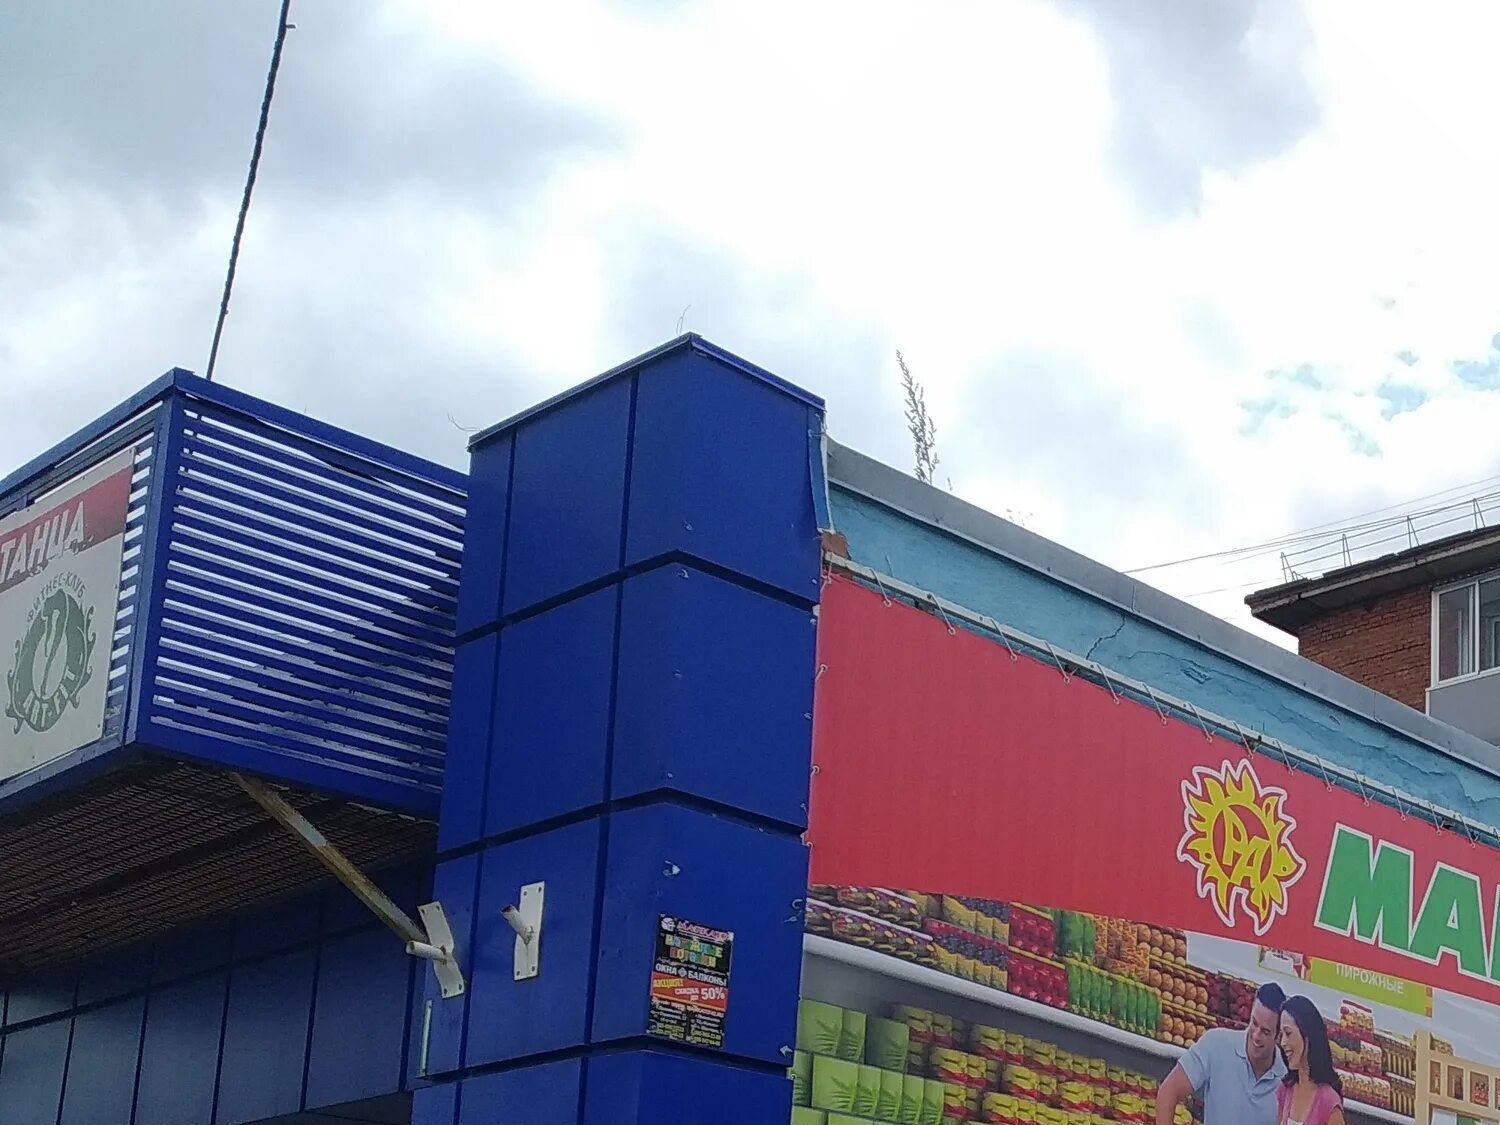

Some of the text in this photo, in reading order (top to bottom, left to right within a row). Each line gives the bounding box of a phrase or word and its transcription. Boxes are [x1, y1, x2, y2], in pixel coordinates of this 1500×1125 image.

[655, 963, 678, 976] ОКНА
[688, 970, 728, 987] БАЛКОНЫ
[1336, 963, 1405, 994] ПИРОЖНЫЕ
[701, 987, 726, 1000] 50%
